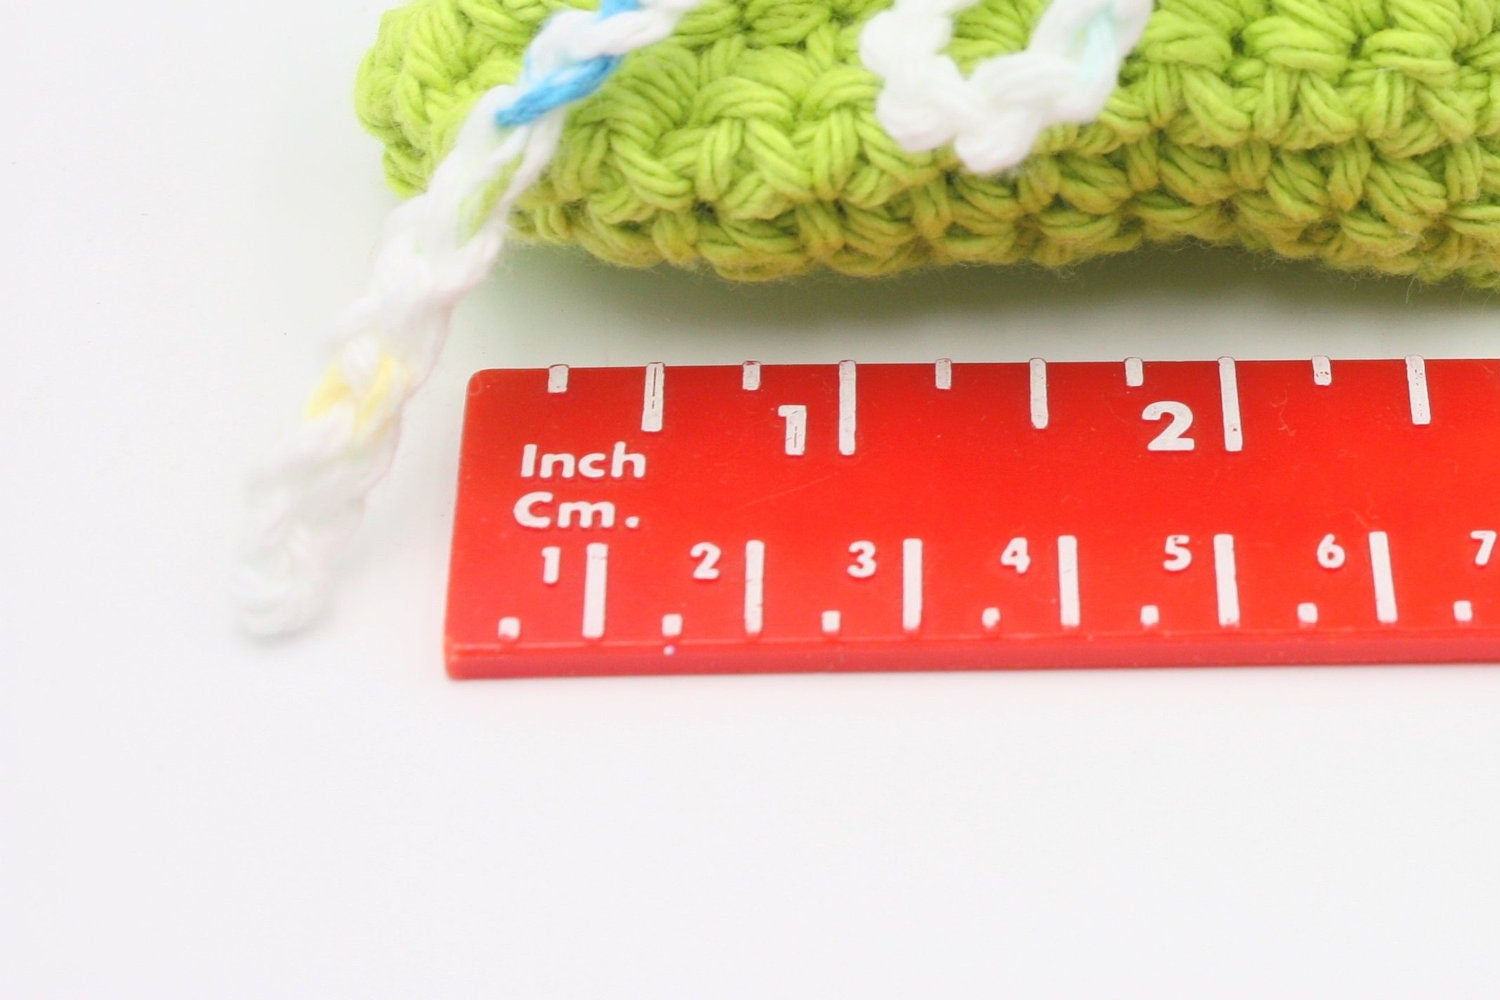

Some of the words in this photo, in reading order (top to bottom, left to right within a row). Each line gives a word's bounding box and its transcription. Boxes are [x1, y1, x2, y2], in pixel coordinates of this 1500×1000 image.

[776, 403, 809, 457] 1
[1140, 399, 1196, 452] 2
[519, 440, 648, 480] Inch
[511, 490, 642, 530] Cm.
[540, 544, 562, 585] 1
[688, 540, 723, 581] 2
[845, 539, 878, 579] 3
[999, 535, 1033, 575] 4
[1162, 533, 1194, 572] 5
[1315, 532, 1347, 570] 6
[1469, 528, 1499, 567] 7
